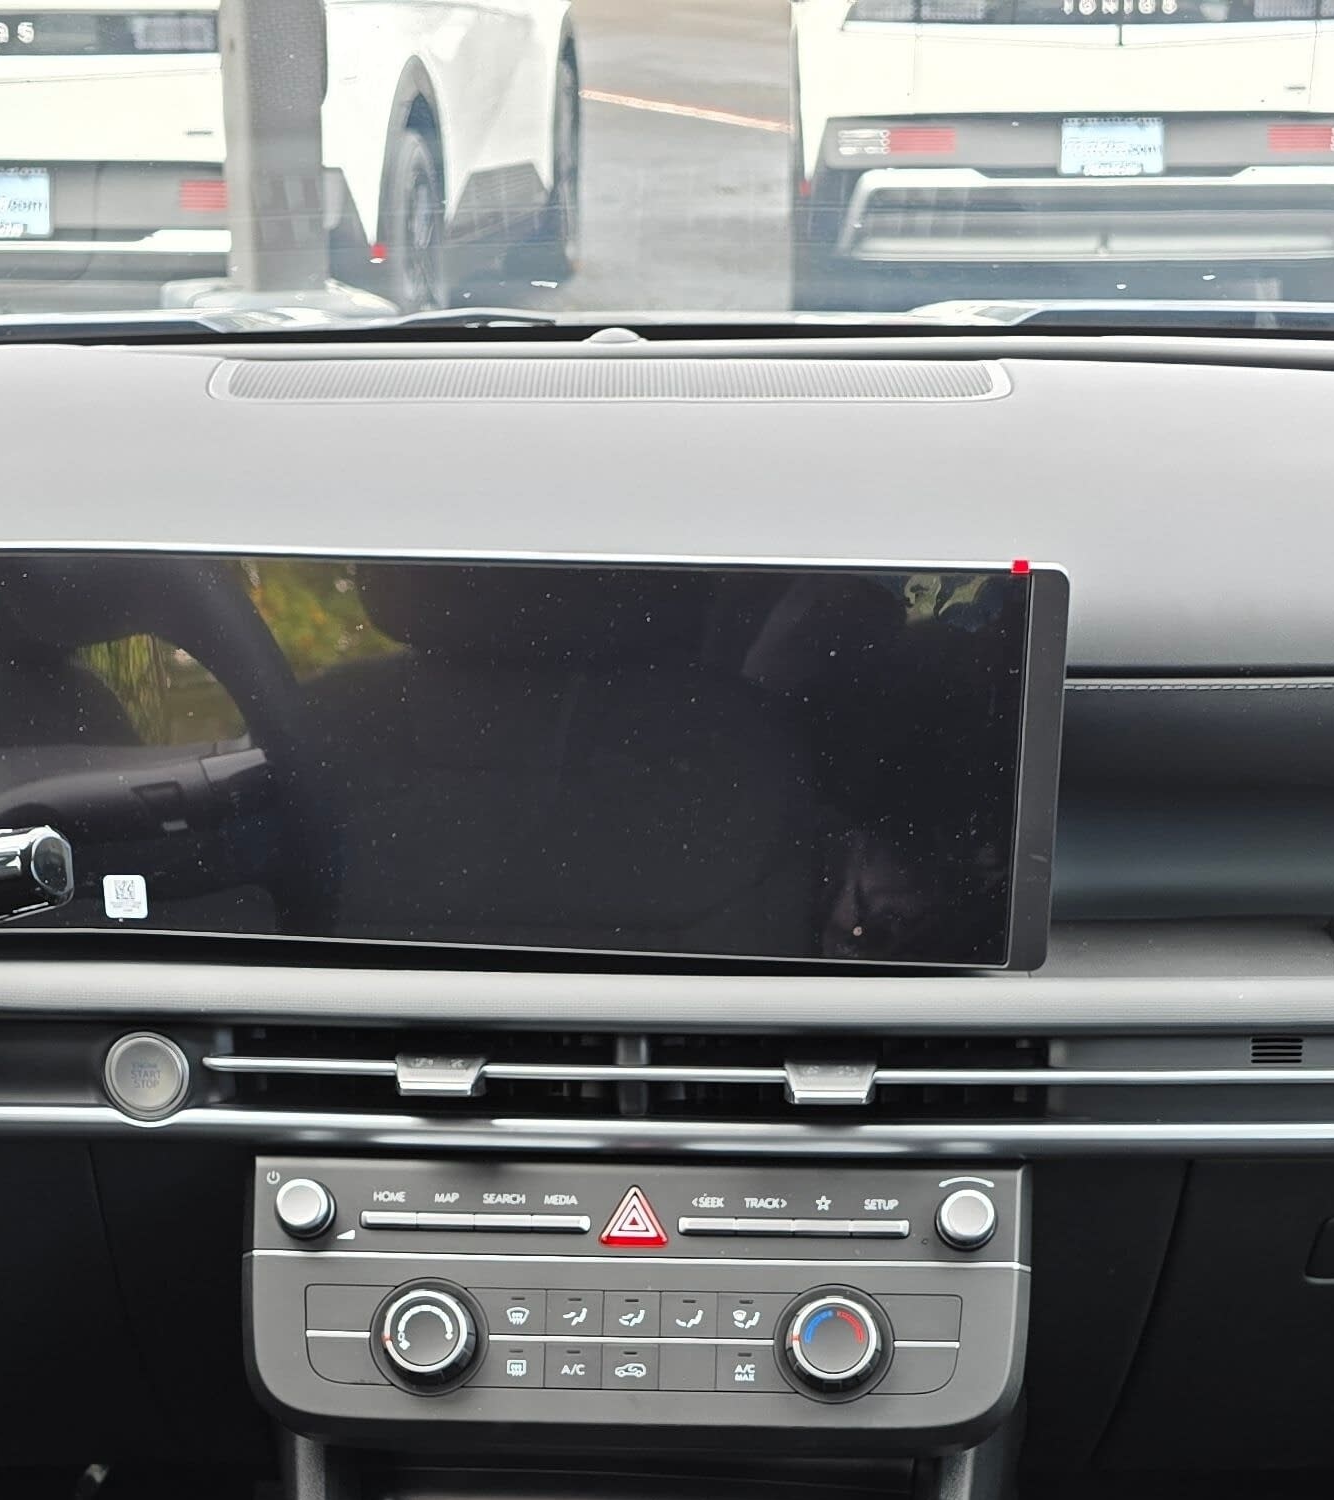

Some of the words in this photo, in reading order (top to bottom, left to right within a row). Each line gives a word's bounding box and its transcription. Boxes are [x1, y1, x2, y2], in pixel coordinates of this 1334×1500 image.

[373, 1190, 407, 1203] HOME
[434, 1192, 460, 1203] MAP
[482, 1193, 526, 1205] SEARCH
[543, 1194, 578, 1206] MEDIA
[863, 1198, 900, 1211] SETUP
[561, 1364, 586, 1376] A/C
[734, 1364, 756, 1374] A/C
[734, 1373, 755, 1382] MAX
